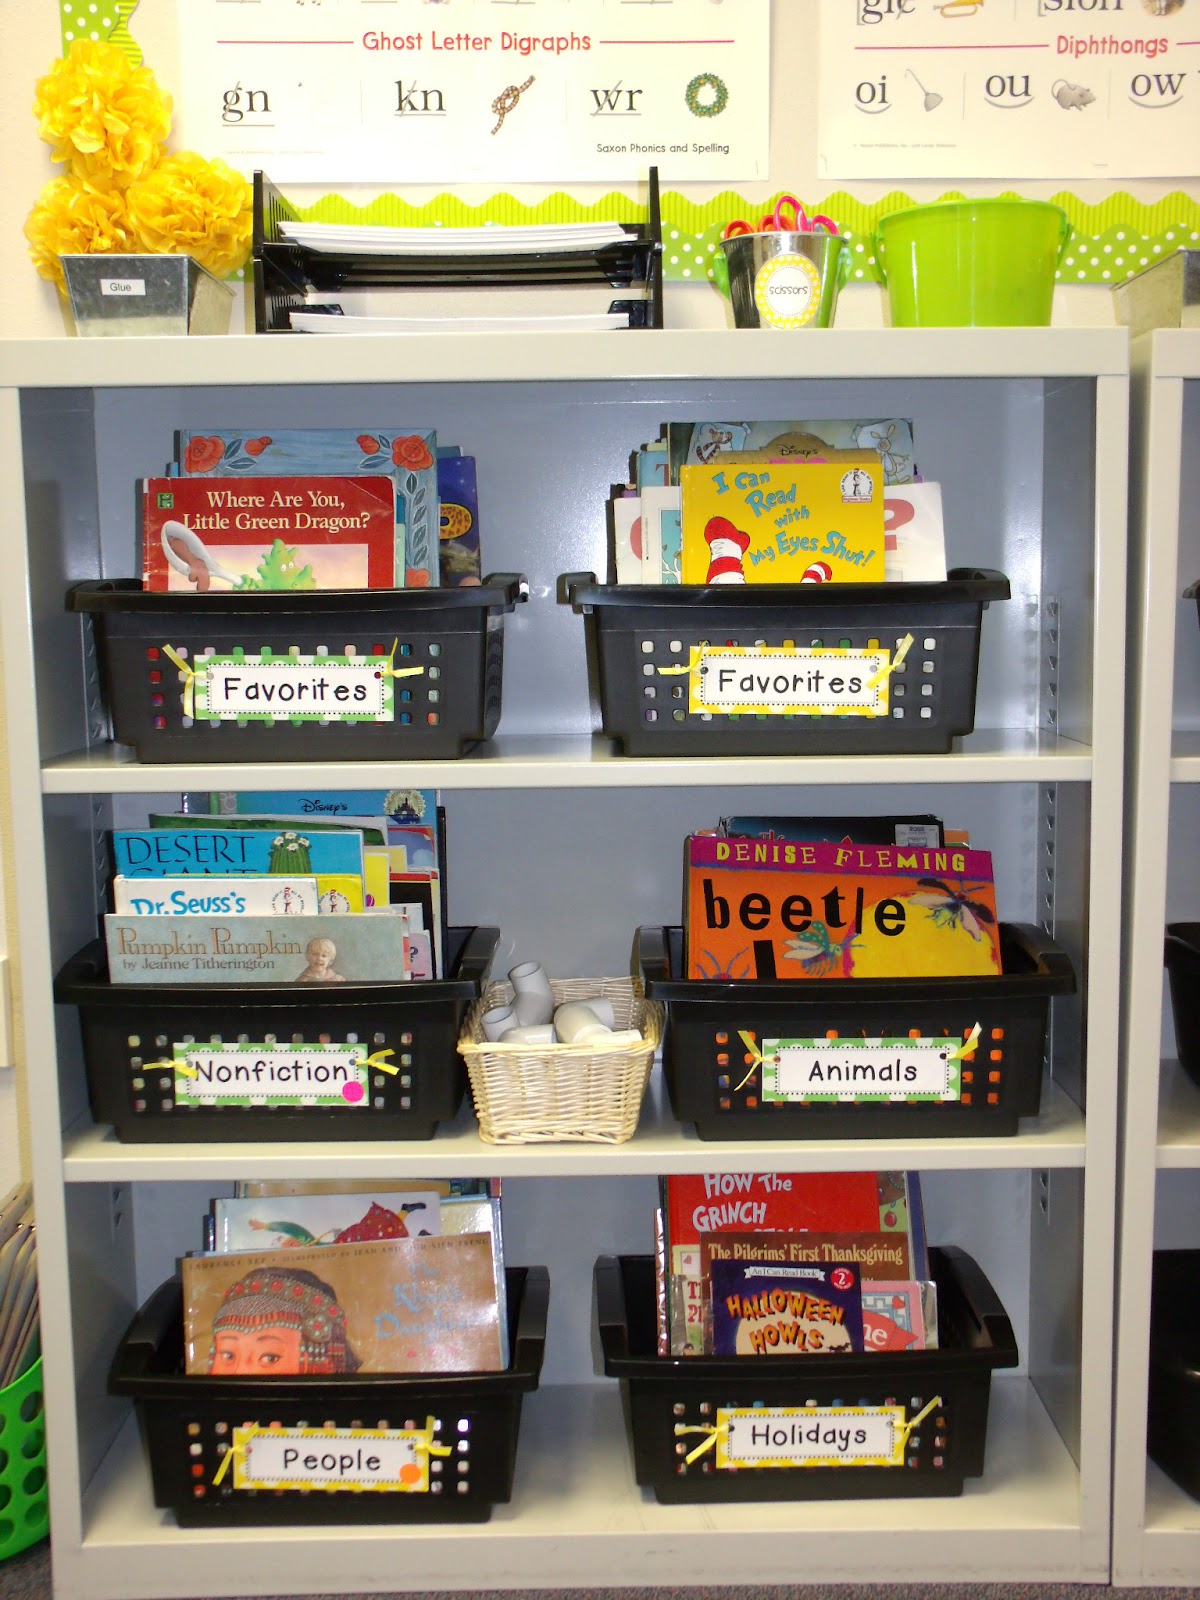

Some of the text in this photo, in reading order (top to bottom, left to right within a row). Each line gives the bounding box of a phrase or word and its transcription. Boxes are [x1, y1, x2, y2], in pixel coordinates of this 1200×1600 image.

[362, 31, 592, 56] Ghost Letter Digraphs
[1057, 35, 1169, 58] Diphthongs
[855, 73, 1187, 104] oi ou ow
[222, 80, 643, 123] gn kn wr
[597, 143, 730, 155] Saxon Phonics and Spelling
[109, 281, 132, 292] Glue
[769, 286, 808, 295] scissors
[778, 444, 818, 458] Disney's
[712, 471, 770, 495] I Can
[206, 491, 345, 510] Where Are You,
[745, 483, 797, 518] Read
[183, 513, 371, 534] Little Green Dragon?
[774, 505, 810, 528] with
[749, 530, 876, 568] My Eyes Shut!
[224, 677, 367, 701] Favorites
[718, 669, 862, 694] Favorites
[298, 798, 348, 814] Disney's
[120, 835, 255, 865] DESERT
[716, 842, 966, 872] DENISE FLEMING
[130, 898, 169, 915] Dr.
[171, 890, 246, 915] Seuss's
[702, 879, 907, 937] beetle
[116, 927, 302, 959] Pumpkin Pumpkin
[123, 956, 275, 973] by Jeanne Titherington
[194, 1060, 348, 1083] Nonfiction
[808, 1058, 918, 1082] Animals
[703, 1173, 792, 1199] HOW The
[692, 1201, 767, 1231] GRINCH
[708, 1243, 903, 1266] The Pilgrims' First Thanksgiving
[752, 1267, 762, 1276] An
[767, 1268, 782, 1276] Can
[782, 1268, 799, 1277] Read
[800, 1269, 818, 1278] Book
[838, 1272, 846, 1285] 2
[726, 1287, 844, 1326] HALLOWEEN
[750, 1321, 825, 1355] HOWLS
[751, 1423, 867, 1452] Holidays
[283, 1448, 381, 1476] People
